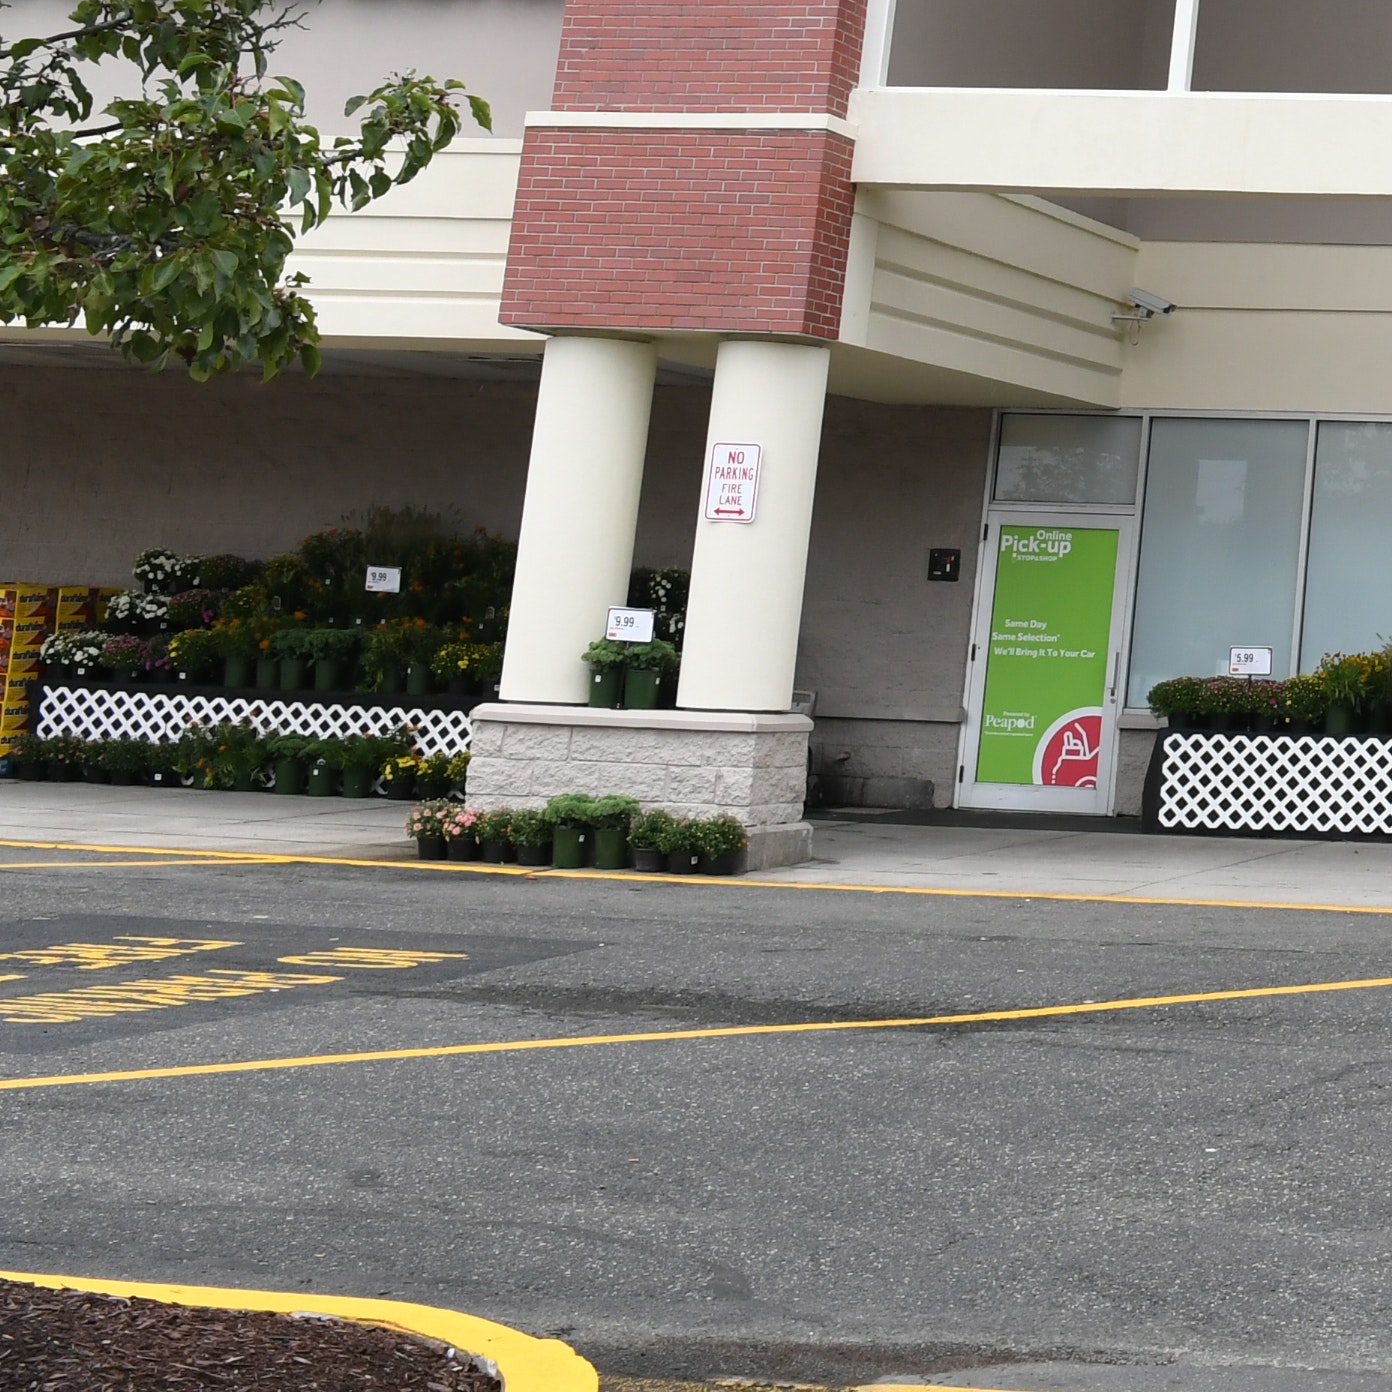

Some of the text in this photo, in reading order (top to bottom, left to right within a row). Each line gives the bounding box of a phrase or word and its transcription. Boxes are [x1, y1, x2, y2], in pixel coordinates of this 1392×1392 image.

[728, 451, 745, 464] NO
[714, 466, 754, 481] PARKING
[721, 483, 743, 494] FIRE
[719, 495, 742, 506] LANE
[1036, 530, 1072, 541] Online
[1001, 534, 1072, 558] Pick-up
[1004, 619, 1047, 630] Same Day
[992, 632, 1016, 641] Same
[994, 647, 1015, 656] We'll
[1016, 648, 1038, 658] Bring
[1047, 649, 1058, 657] To
[1060, 650, 1080, 658] Your
[1081, 650, 1096, 658] Car
[985, 715, 1035, 731] Peapod
[277, 946, 469, 969] NO
